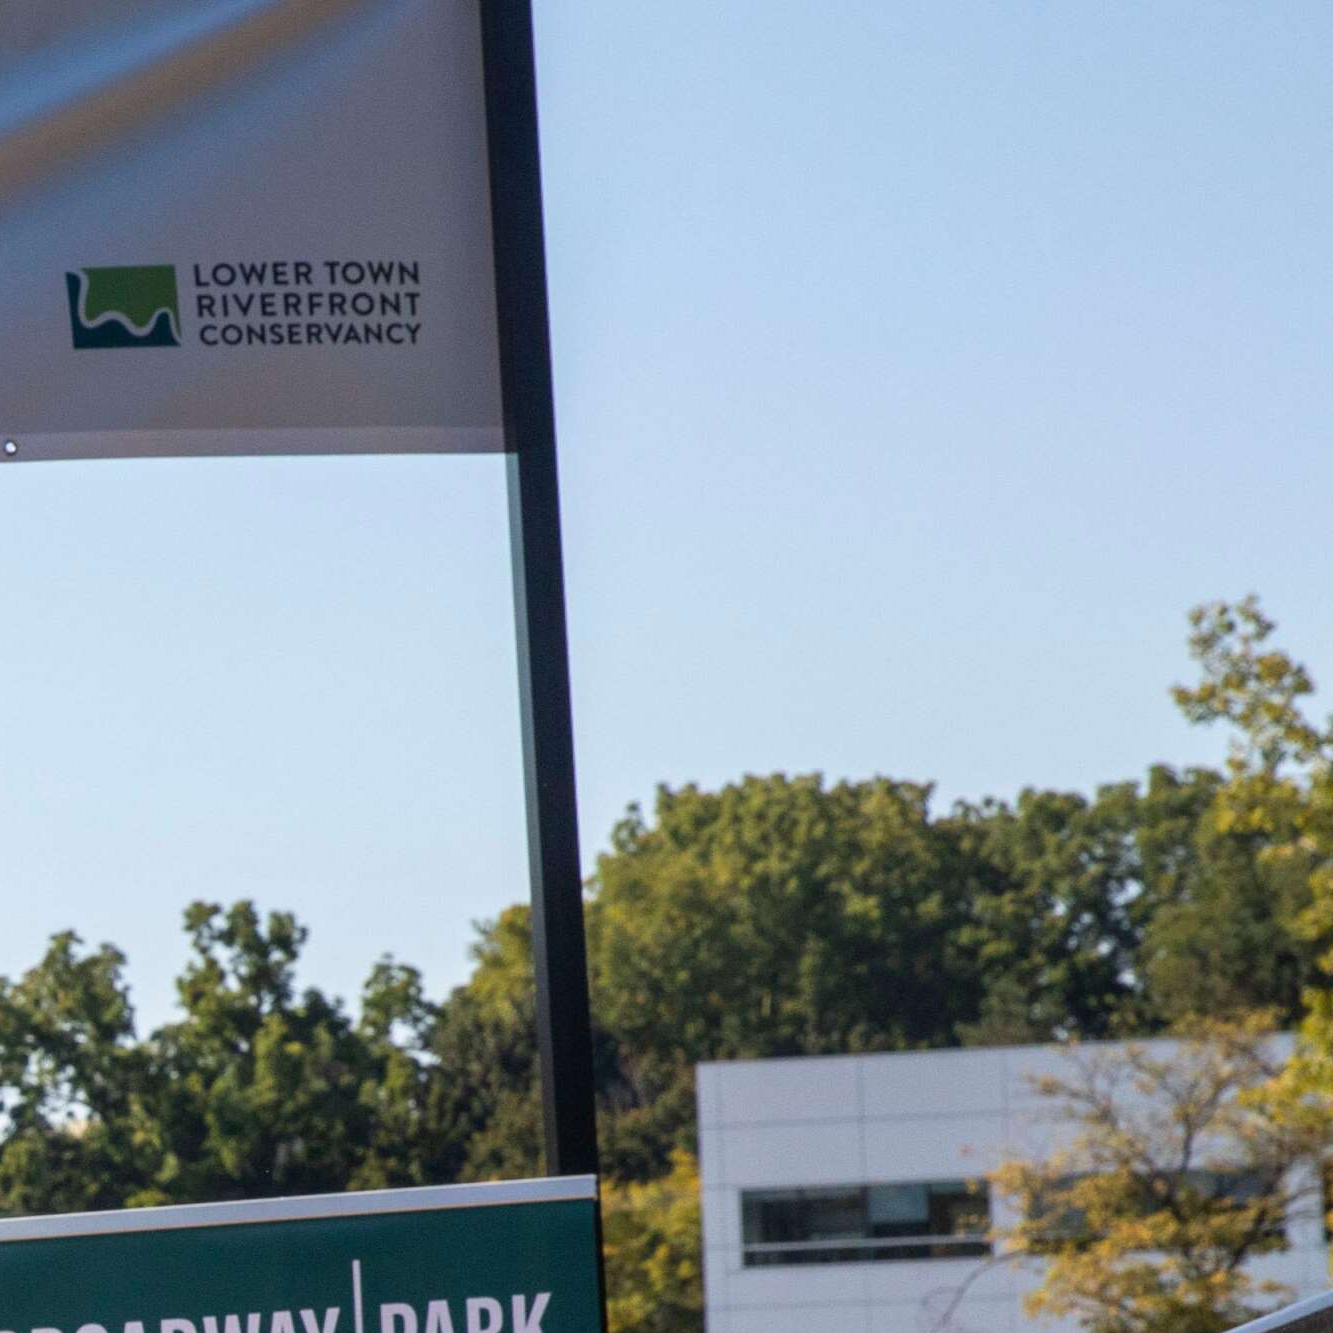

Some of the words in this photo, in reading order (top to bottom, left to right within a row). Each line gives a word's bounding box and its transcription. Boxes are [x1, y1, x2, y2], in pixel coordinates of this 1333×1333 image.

[194, 262, 313, 287] LOWER
[324, 260, 420, 285] TOWN
[197, 292, 421, 318] RIVERFRONT
[199, 322, 422, 346] CONSERVANCY
